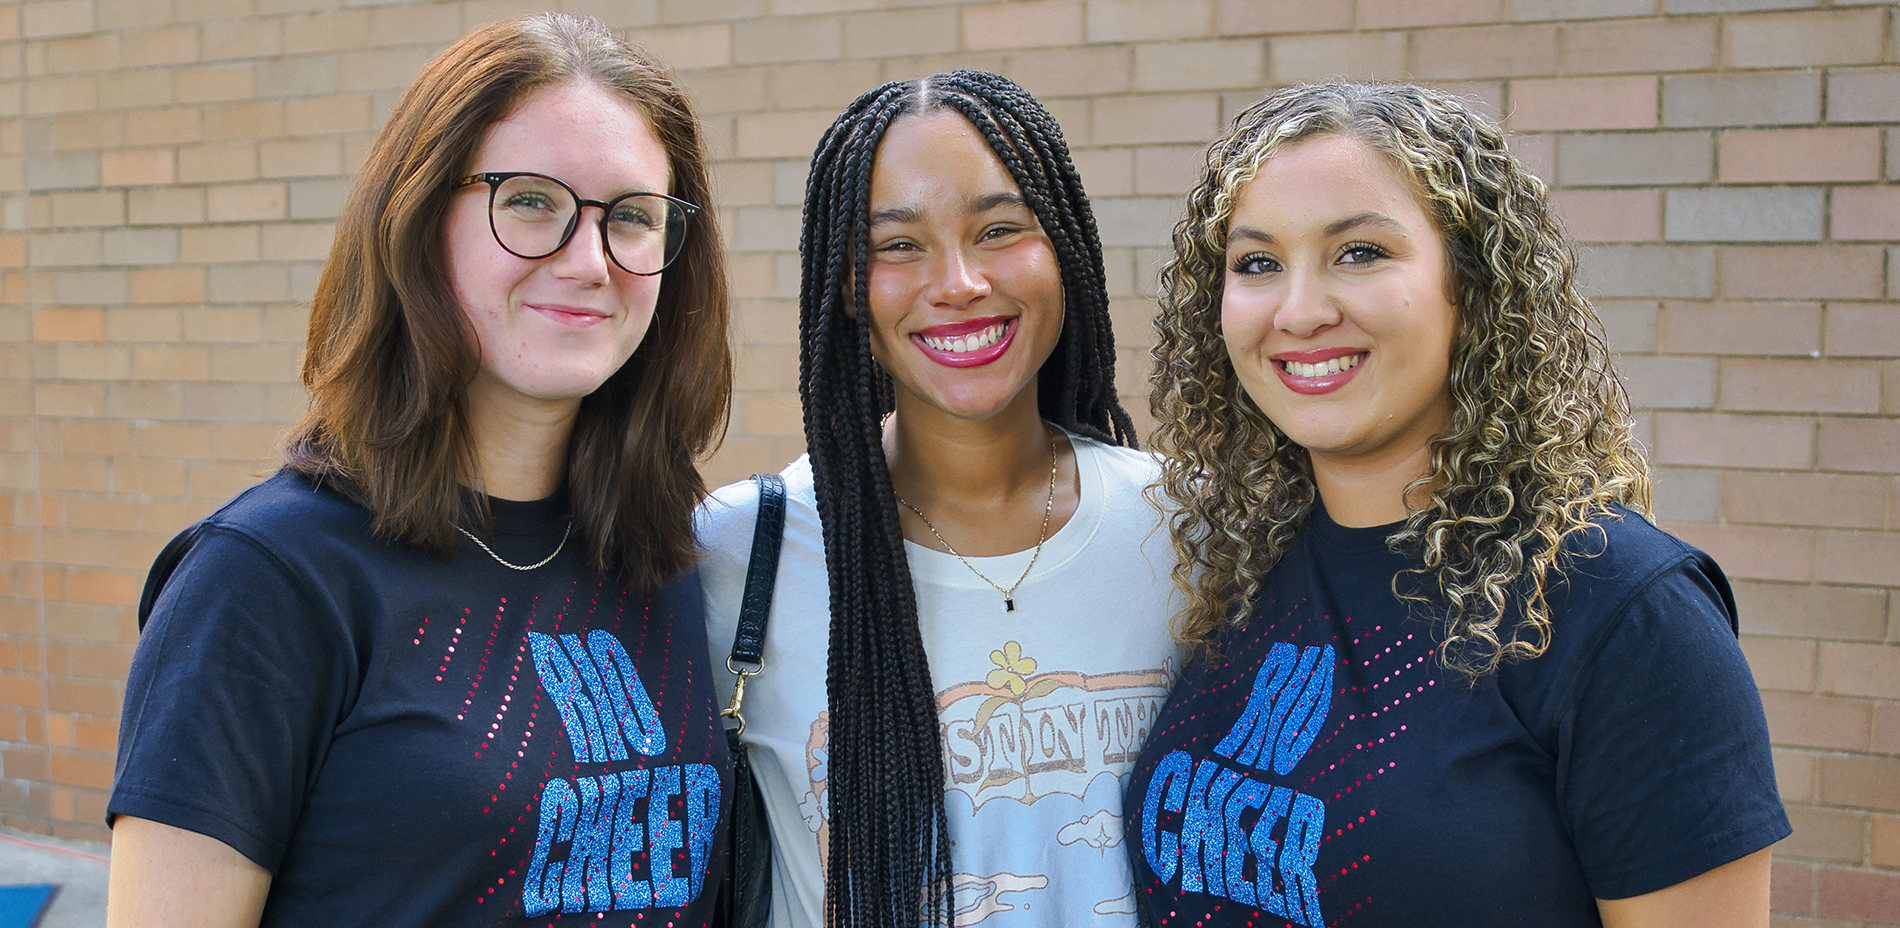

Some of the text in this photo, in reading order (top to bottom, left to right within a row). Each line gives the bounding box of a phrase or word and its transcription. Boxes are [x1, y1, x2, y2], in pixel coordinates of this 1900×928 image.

[528, 629, 667, 763] RIO
[940, 695, 1169, 785] ST IN TH
[1213, 641, 1336, 776] RIO
[522, 763, 721, 918] CHEER
[1142, 750, 1326, 928] CHEER
